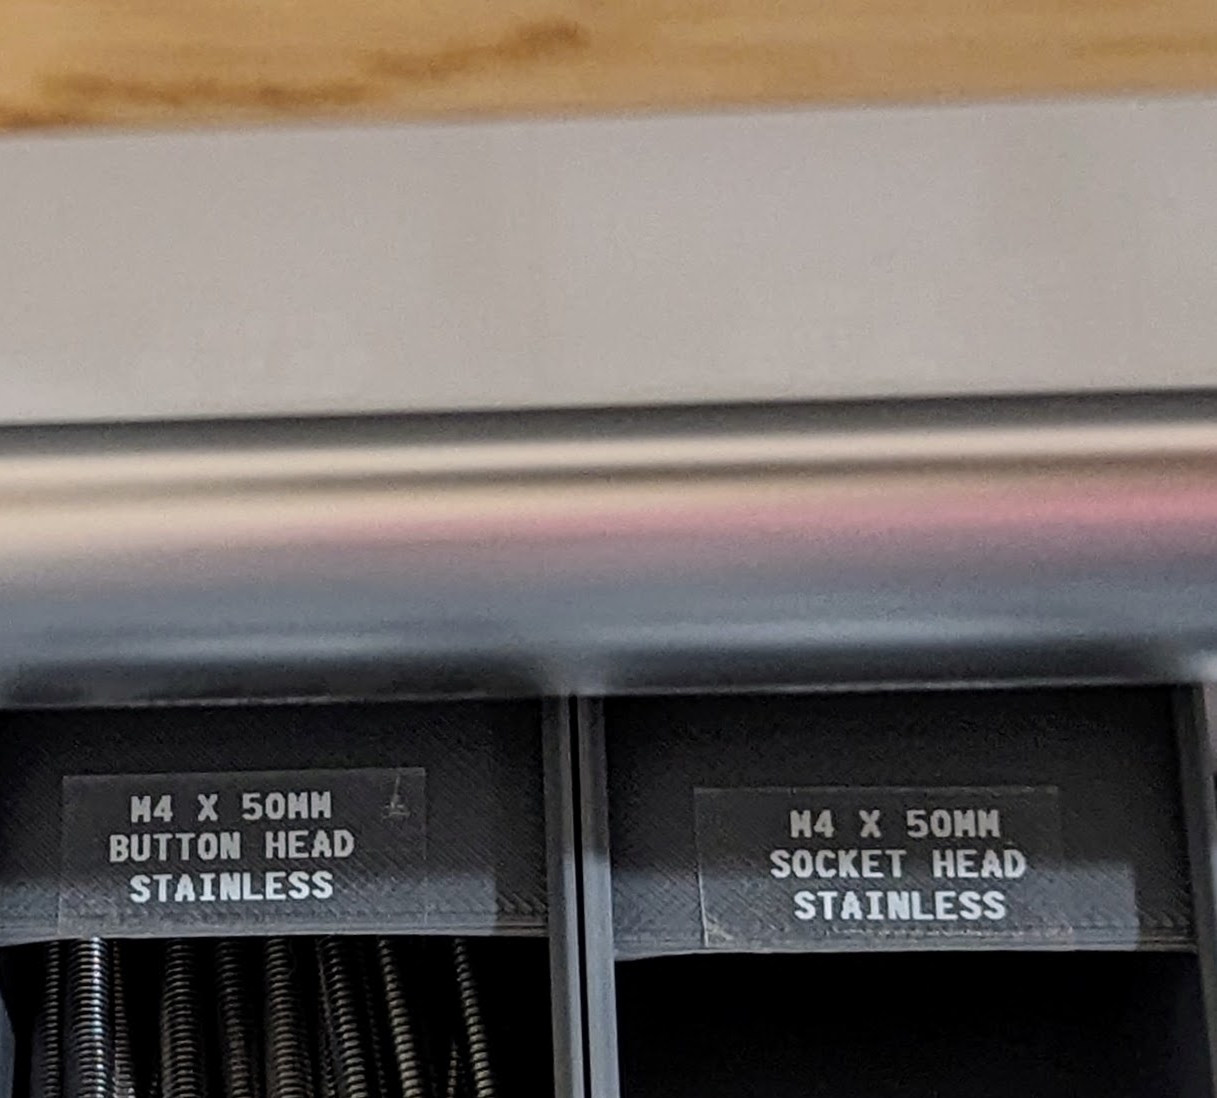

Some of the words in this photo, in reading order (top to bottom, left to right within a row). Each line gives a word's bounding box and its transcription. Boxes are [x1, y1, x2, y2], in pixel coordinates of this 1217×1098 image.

[131, 795, 173, 823] M4
[197, 794, 218, 821] X
[242, 791, 332, 820] 50MM
[790, 810, 834, 838] M4
[860, 810, 881, 838] X
[906, 809, 1000, 838] 50MM
[109, 831, 241, 862] BUTTON
[265, 830, 355, 859] HEAD
[770, 850, 906, 878] SOCKET
[932, 850, 1027, 878] HEAD
[130, 871, 333, 903] STAINLESS
[794, 890, 1006, 920] STAINLESS
